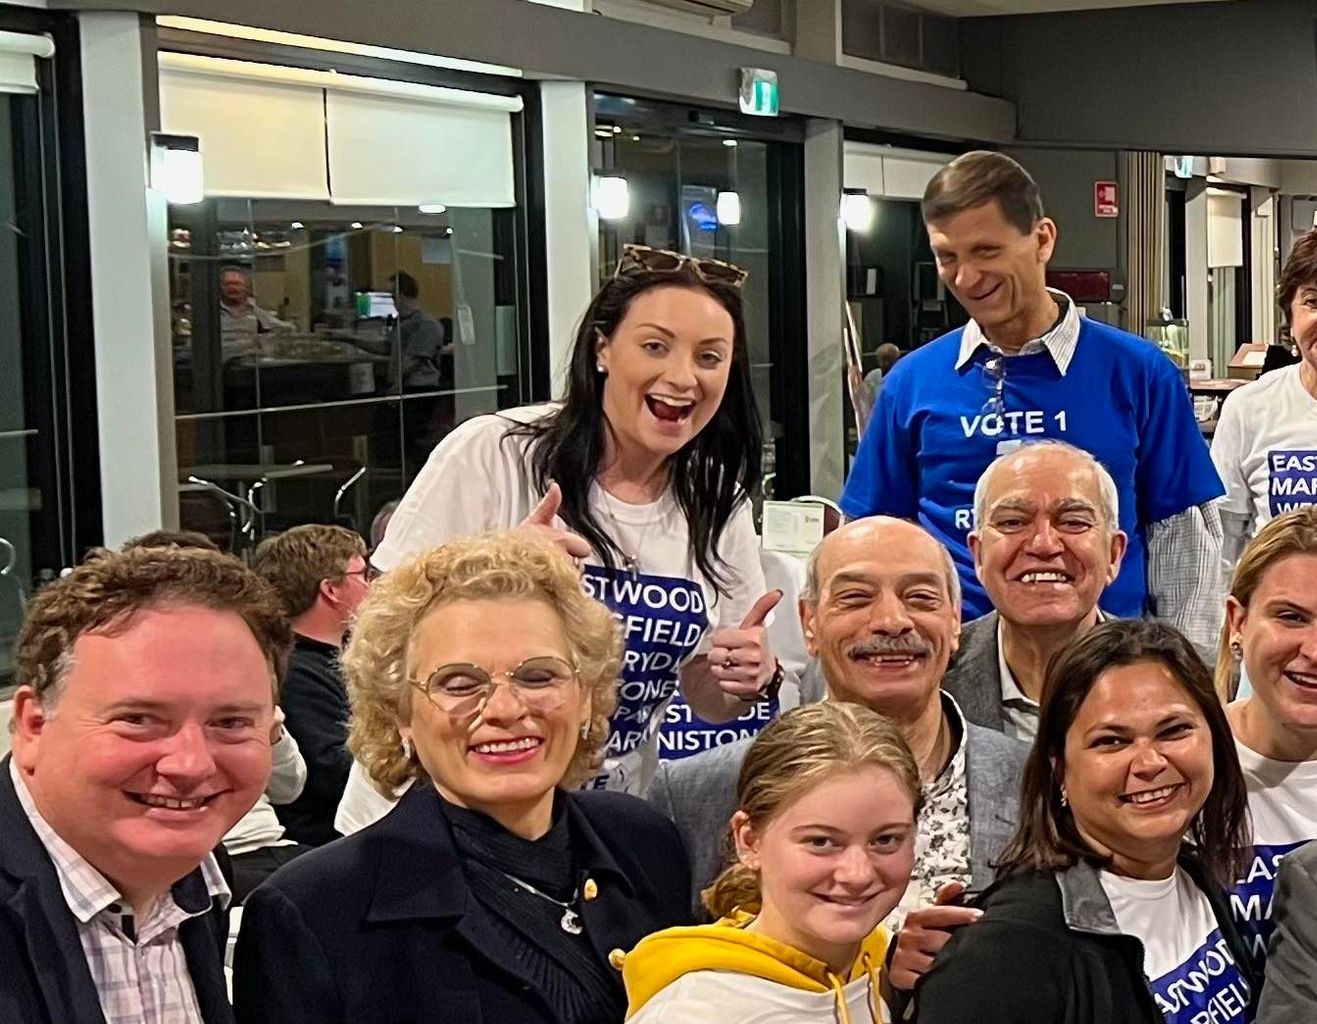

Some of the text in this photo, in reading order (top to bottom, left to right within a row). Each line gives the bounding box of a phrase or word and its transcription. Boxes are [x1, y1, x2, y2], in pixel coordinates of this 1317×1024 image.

[960, 410, 1067, 437] VOTE 1
[582, 574, 704, 614] STWOOD
[614, 614, 701, 647] FIELD
